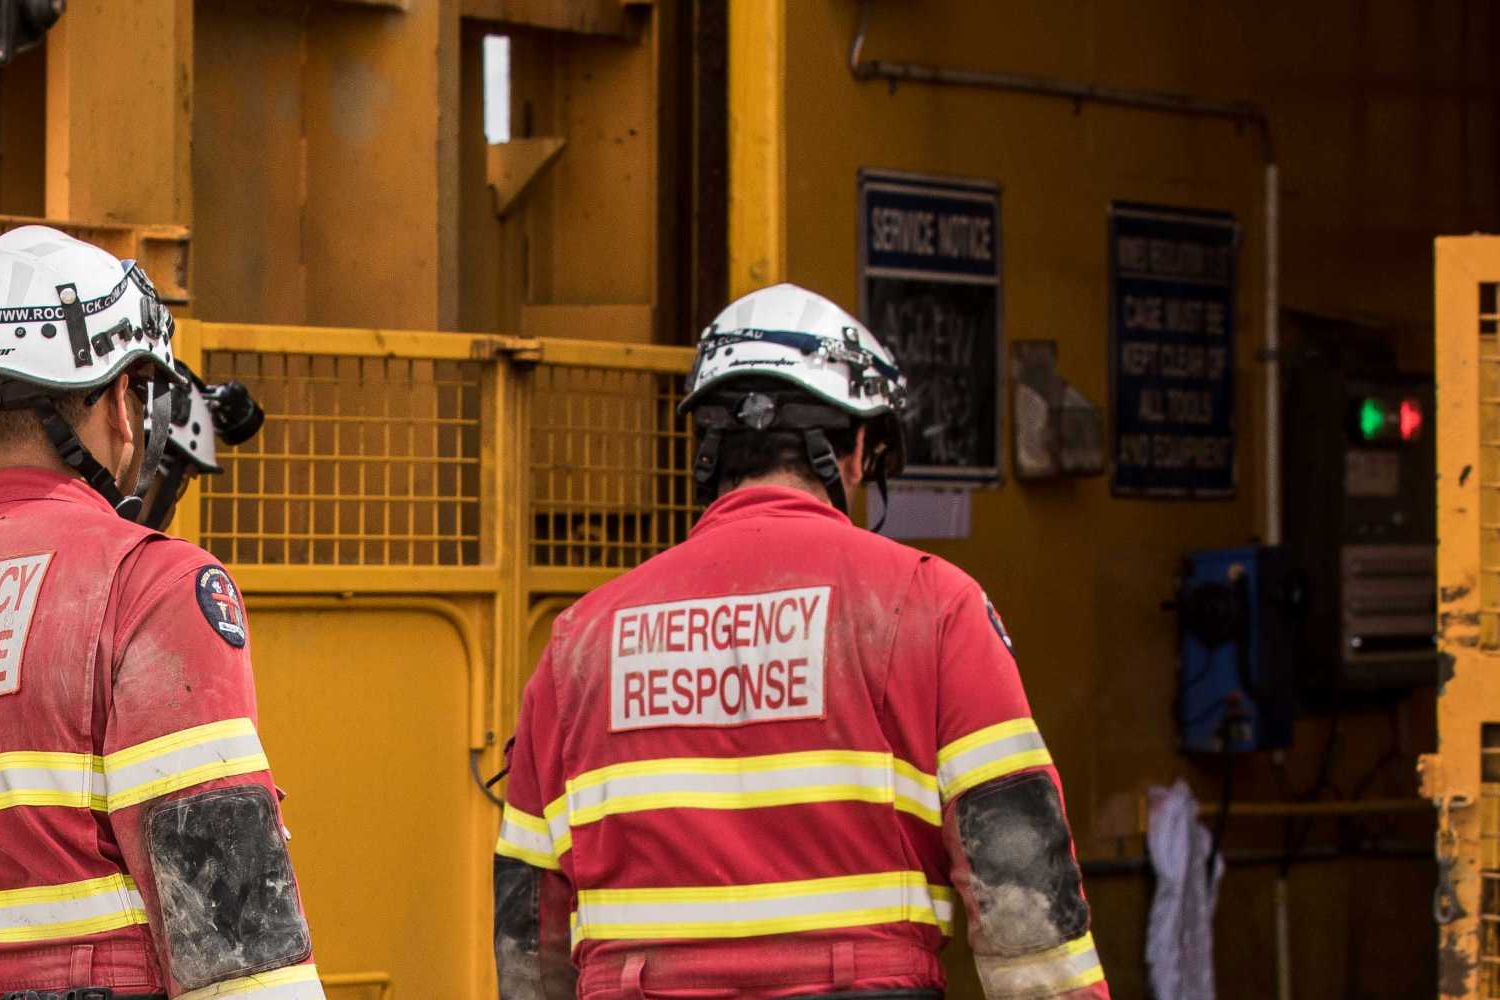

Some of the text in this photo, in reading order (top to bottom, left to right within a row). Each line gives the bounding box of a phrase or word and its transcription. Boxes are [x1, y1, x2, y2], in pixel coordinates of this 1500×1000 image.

[871, 207, 992, 260] SERVICE NOTICE
[617, 595, 820, 658] EMERGENCY
[623, 658, 809, 719] RESPONSE
